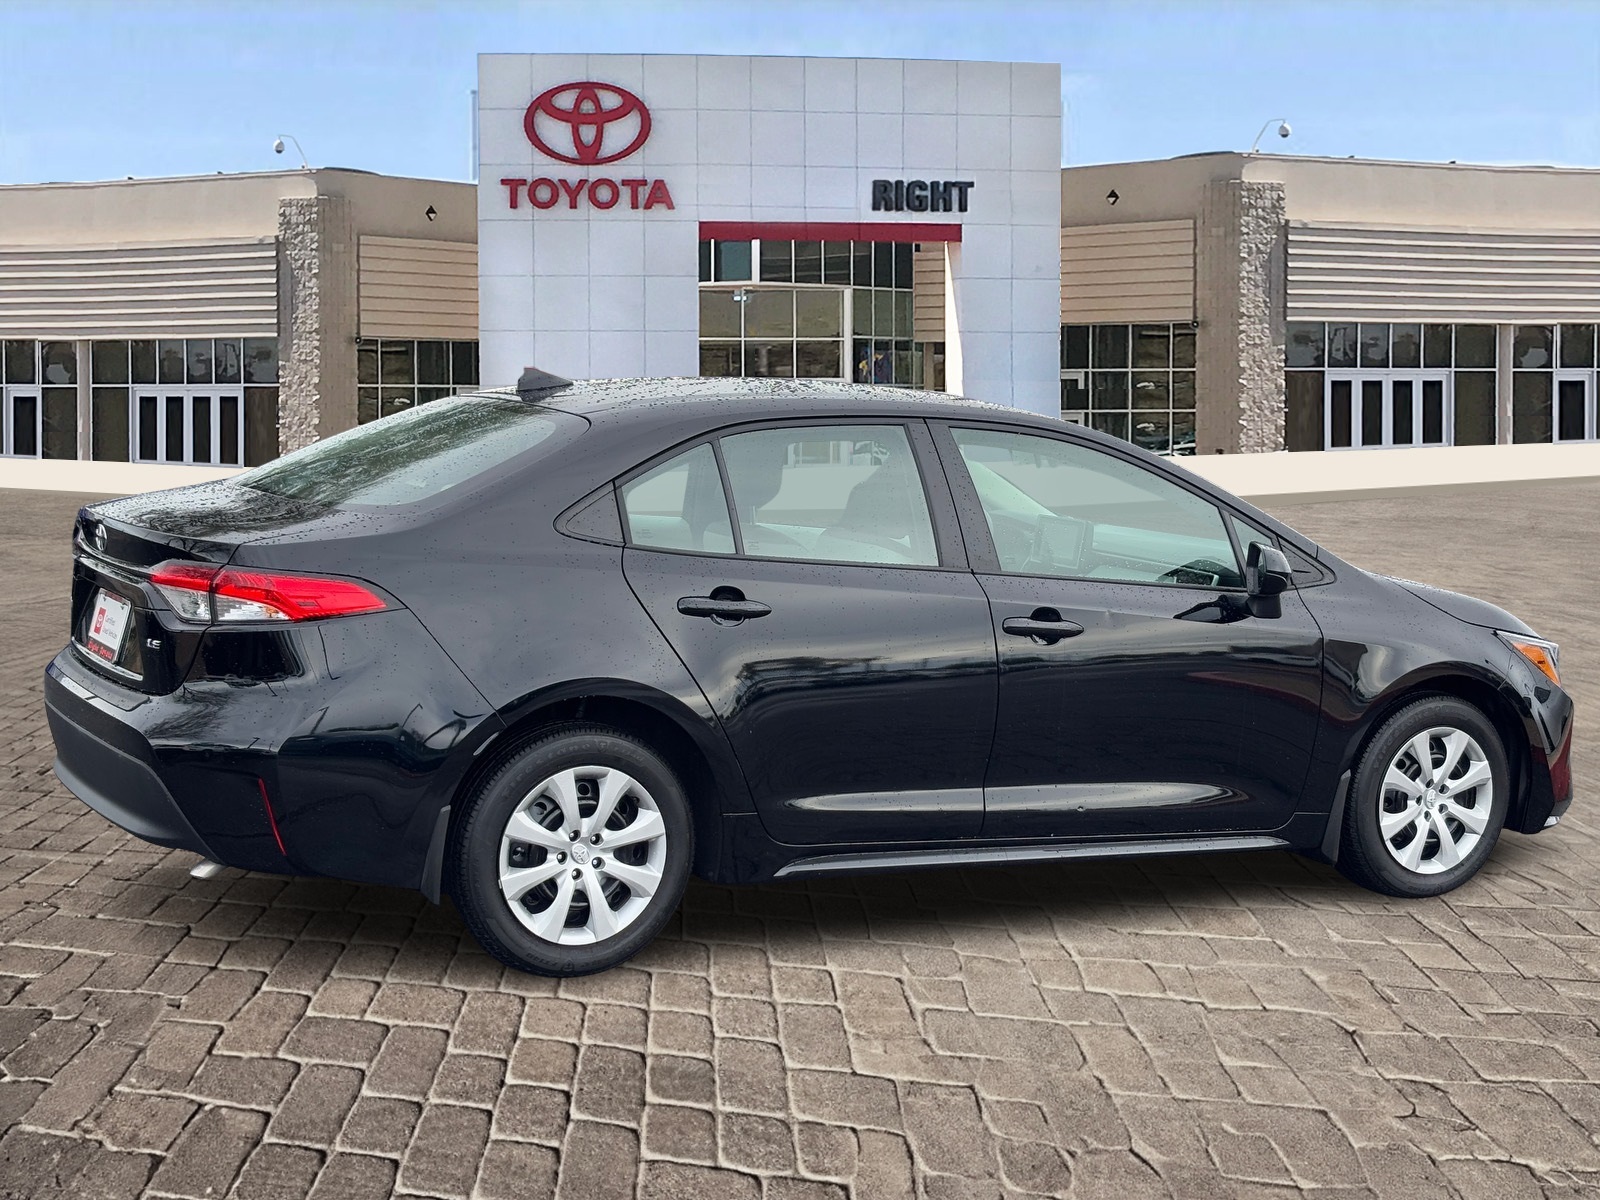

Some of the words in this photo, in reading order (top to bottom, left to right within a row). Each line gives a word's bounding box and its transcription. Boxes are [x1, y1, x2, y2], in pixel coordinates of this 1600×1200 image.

[501, 178, 675, 209] TOYOTA
[872, 180, 974, 212] RIGHT
[146, 638, 161, 649] LE
